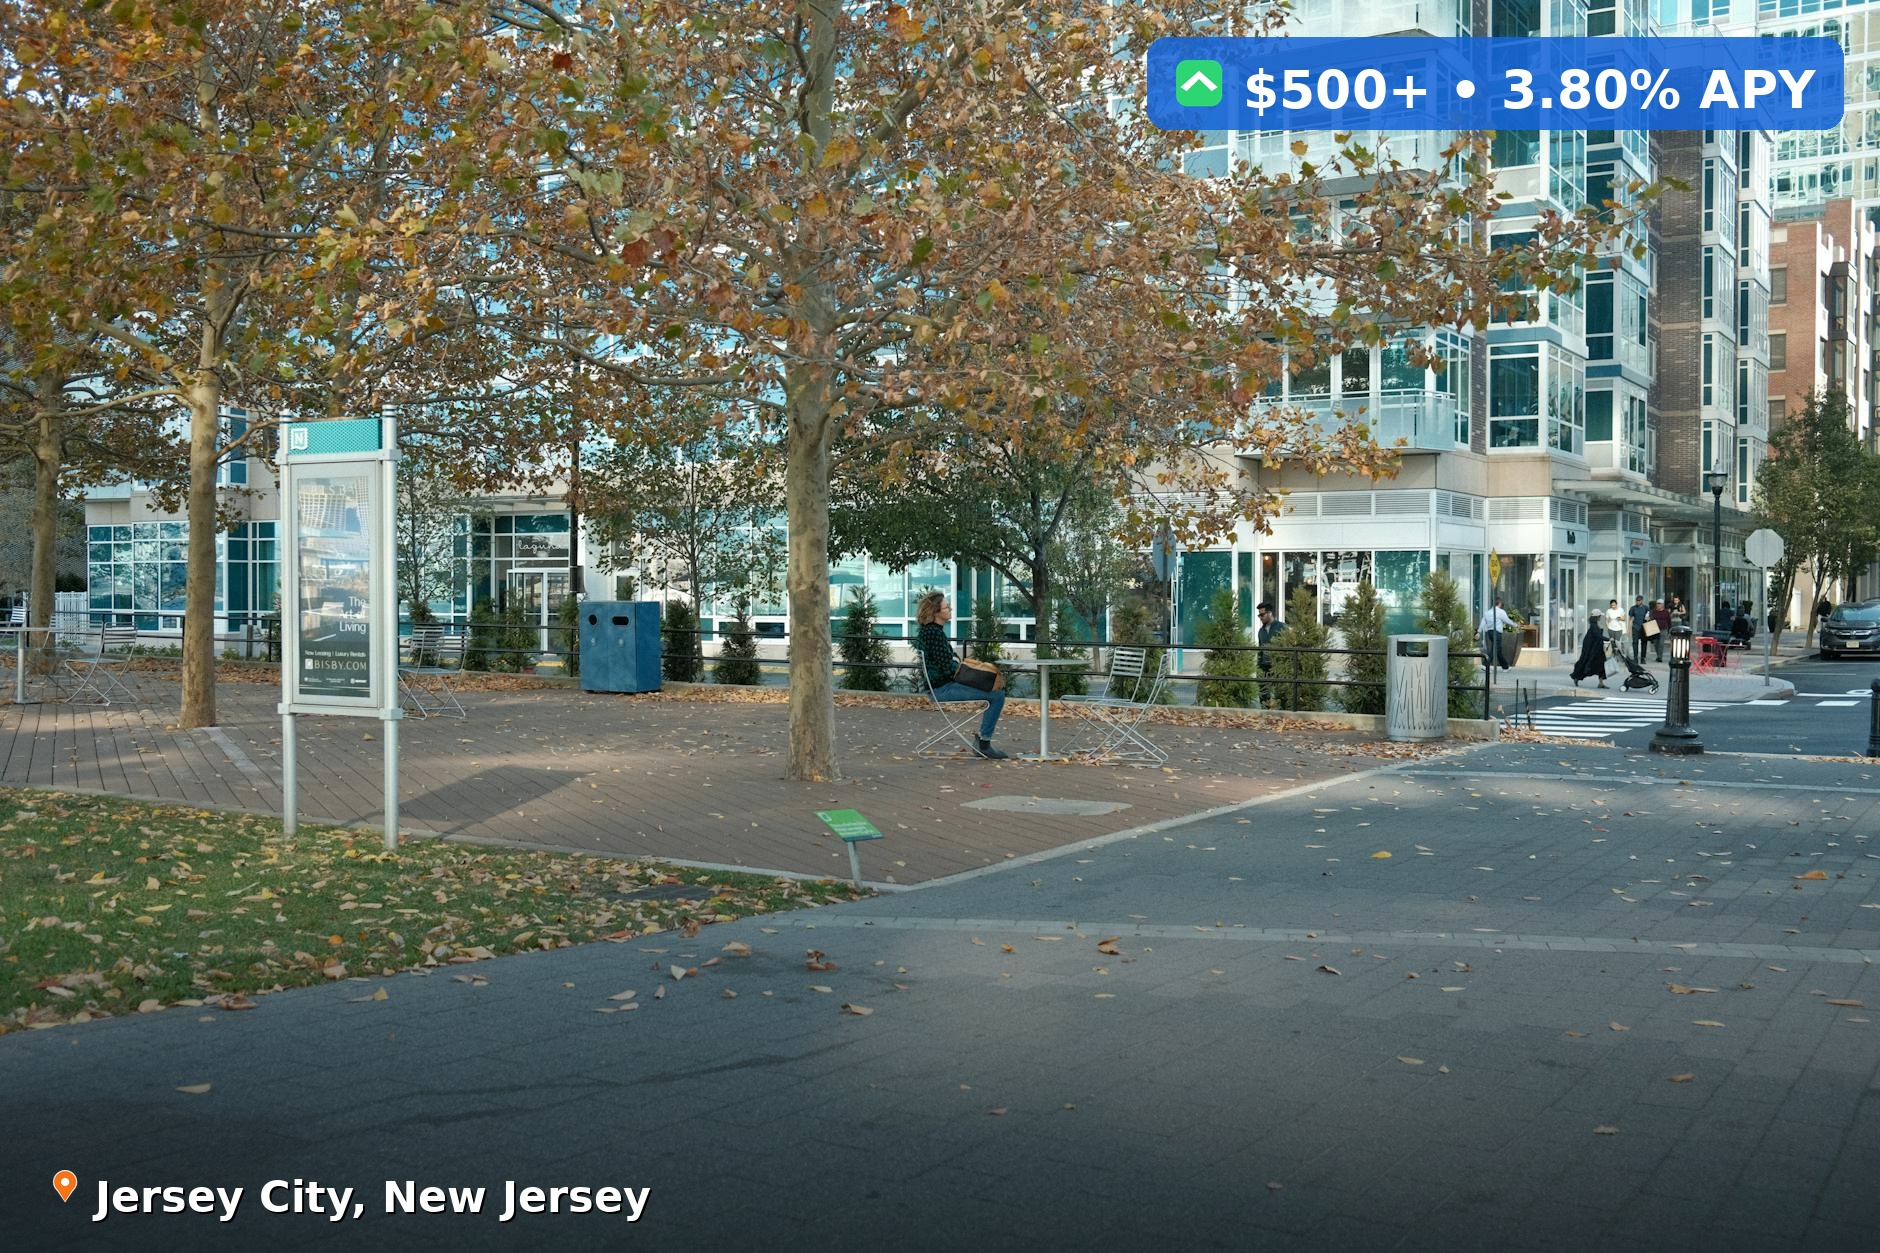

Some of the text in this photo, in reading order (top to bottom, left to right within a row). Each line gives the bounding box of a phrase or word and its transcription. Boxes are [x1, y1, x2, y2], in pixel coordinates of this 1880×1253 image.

[518, 539, 561, 554] laguna
[349, 596, 366, 607] The
[339, 621, 366, 635] Living
[314, 659, 367, 671] BISBY.COM
